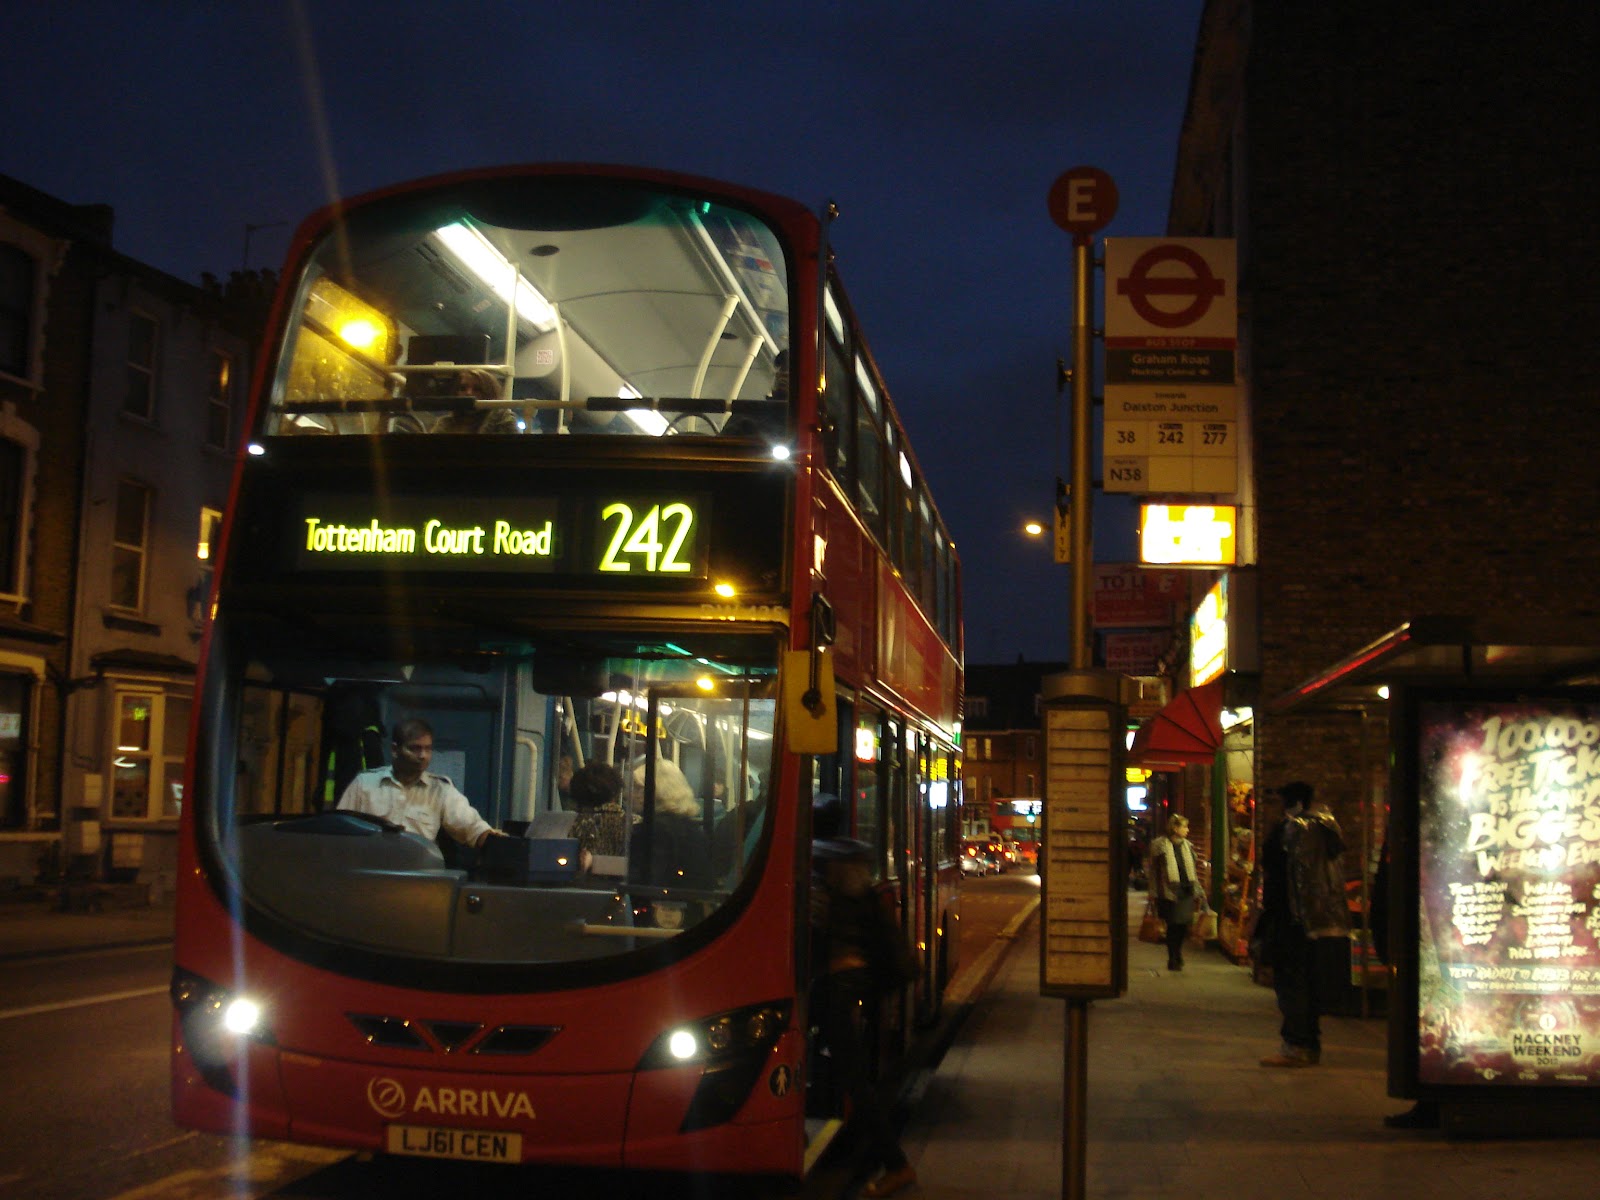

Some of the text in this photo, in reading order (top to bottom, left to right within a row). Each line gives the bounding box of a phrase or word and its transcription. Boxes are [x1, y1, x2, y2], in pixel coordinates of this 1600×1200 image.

[1068, 179, 1096, 221] E
[1132, 354, 1210, 365] Graham Road
[1123, 402, 1218, 413] Dalston Junction
[1117, 431, 1136, 444] 38
[1158, 431, 1184, 444] 242
[1203, 432, 1227, 445] 277
[1110, 468, 1142, 481] N38
[305, 518, 552, 555] Tottenham Court Road
[599, 503, 693, 572] 242
[1513, 1034, 1582, 1045] HACKNEY
[1514, 1045, 1582, 1057] WEEKEND
[413, 1087, 537, 1119] ARRIVA
[402, 1129, 508, 1158] LJ61 CEN
